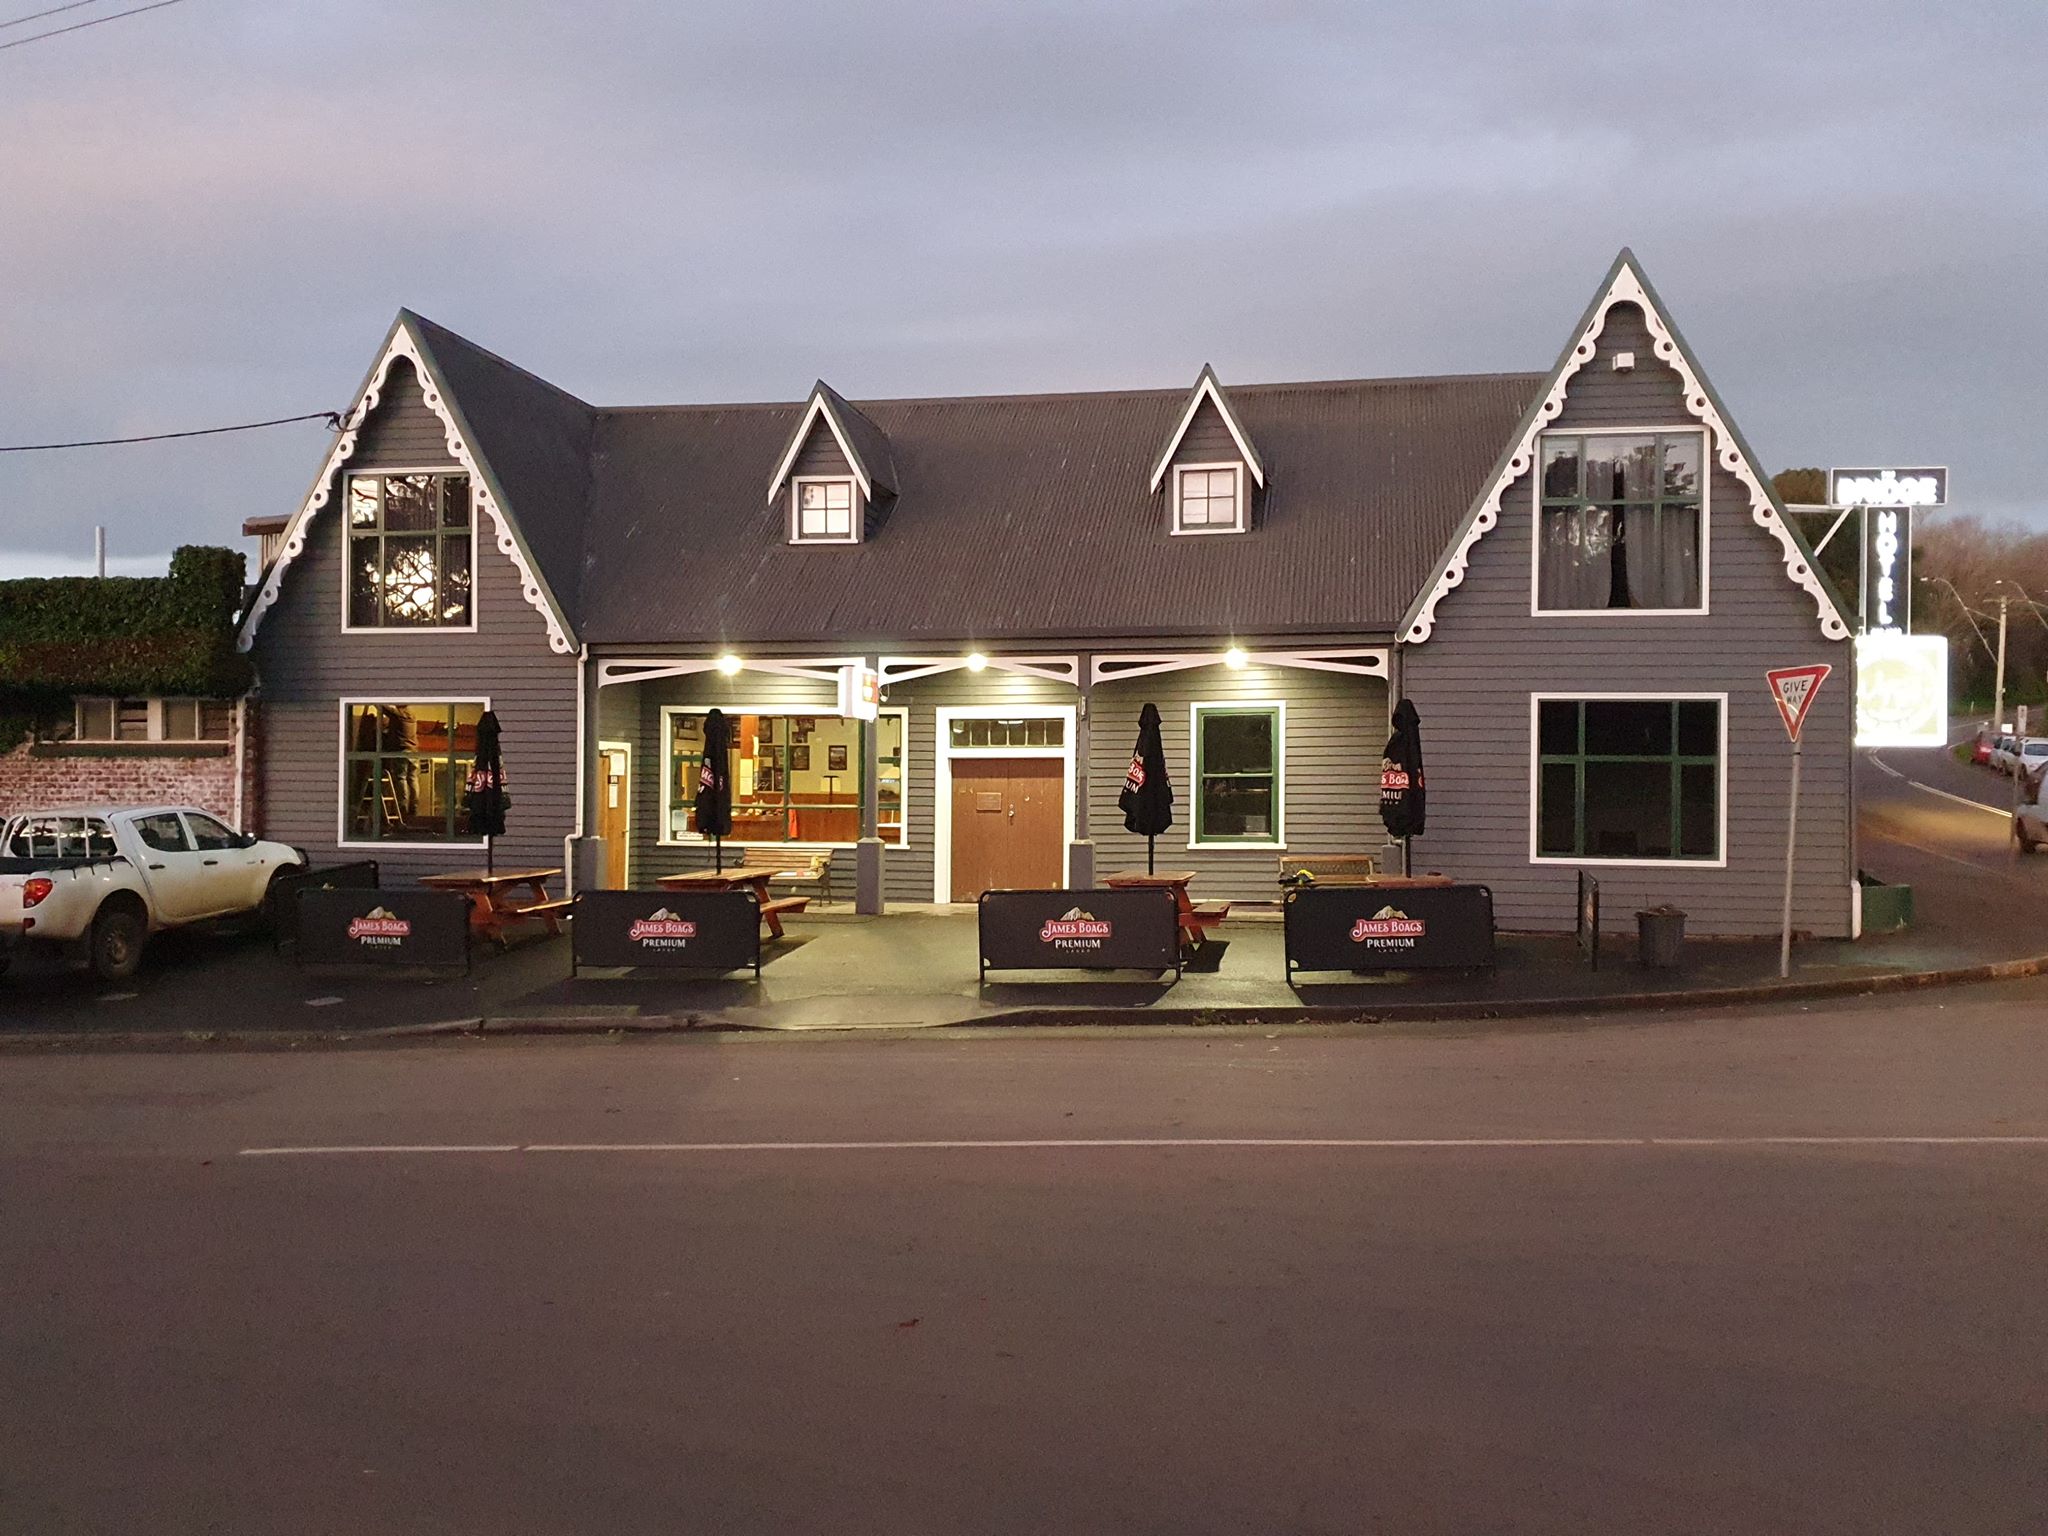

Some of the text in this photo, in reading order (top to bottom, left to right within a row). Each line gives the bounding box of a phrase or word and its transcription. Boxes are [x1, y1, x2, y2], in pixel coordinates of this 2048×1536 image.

[1783, 680, 1808, 693] GIVE
[1787, 696, 1804, 704] WAY
[630, 922, 664, 937] JAMES
[1041, 922, 1077, 938] JAMES
[1352, 921, 1389, 937] JAMES
[361, 936, 401, 945] PREMIUM
[642, 938, 686, 947] PREMIUM
[1055, 939, 1101, 949] PREMIUM
[1367, 938, 1415, 949] PREMIUM
